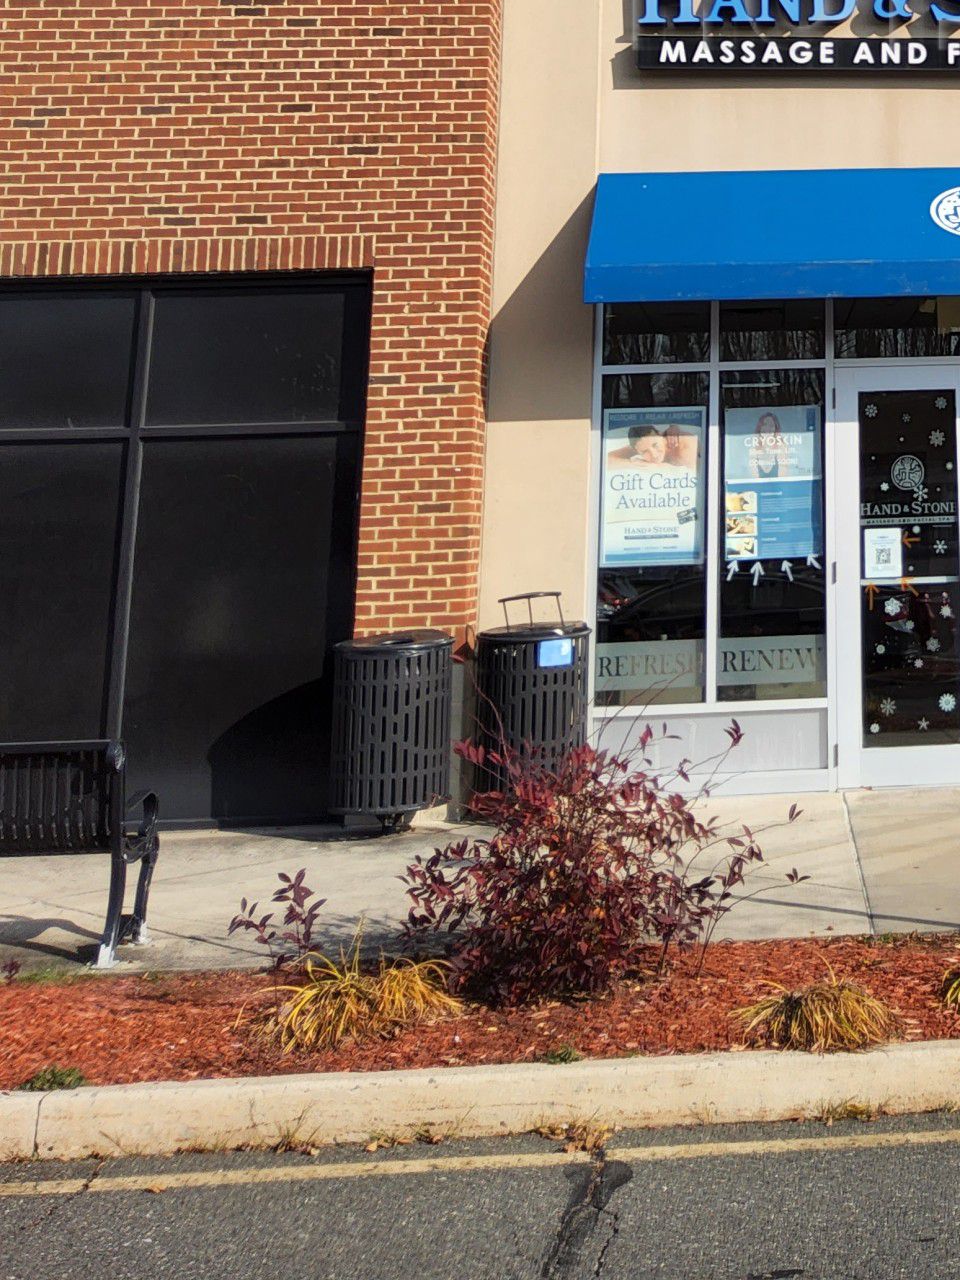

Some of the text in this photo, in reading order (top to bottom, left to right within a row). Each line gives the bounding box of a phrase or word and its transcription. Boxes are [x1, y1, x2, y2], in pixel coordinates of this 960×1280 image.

[659, 40, 835, 64] MASSAGE
[853, 42, 928, 65] AND
[744, 434, 802, 448] CRYOSKIN
[610, 472, 698, 491] Gift Cards
[616, 492, 690, 510] Available
[860, 502, 901, 516] HAND
[903, 504, 909, 513] &
[721, 647, 822, 673] RENEW
